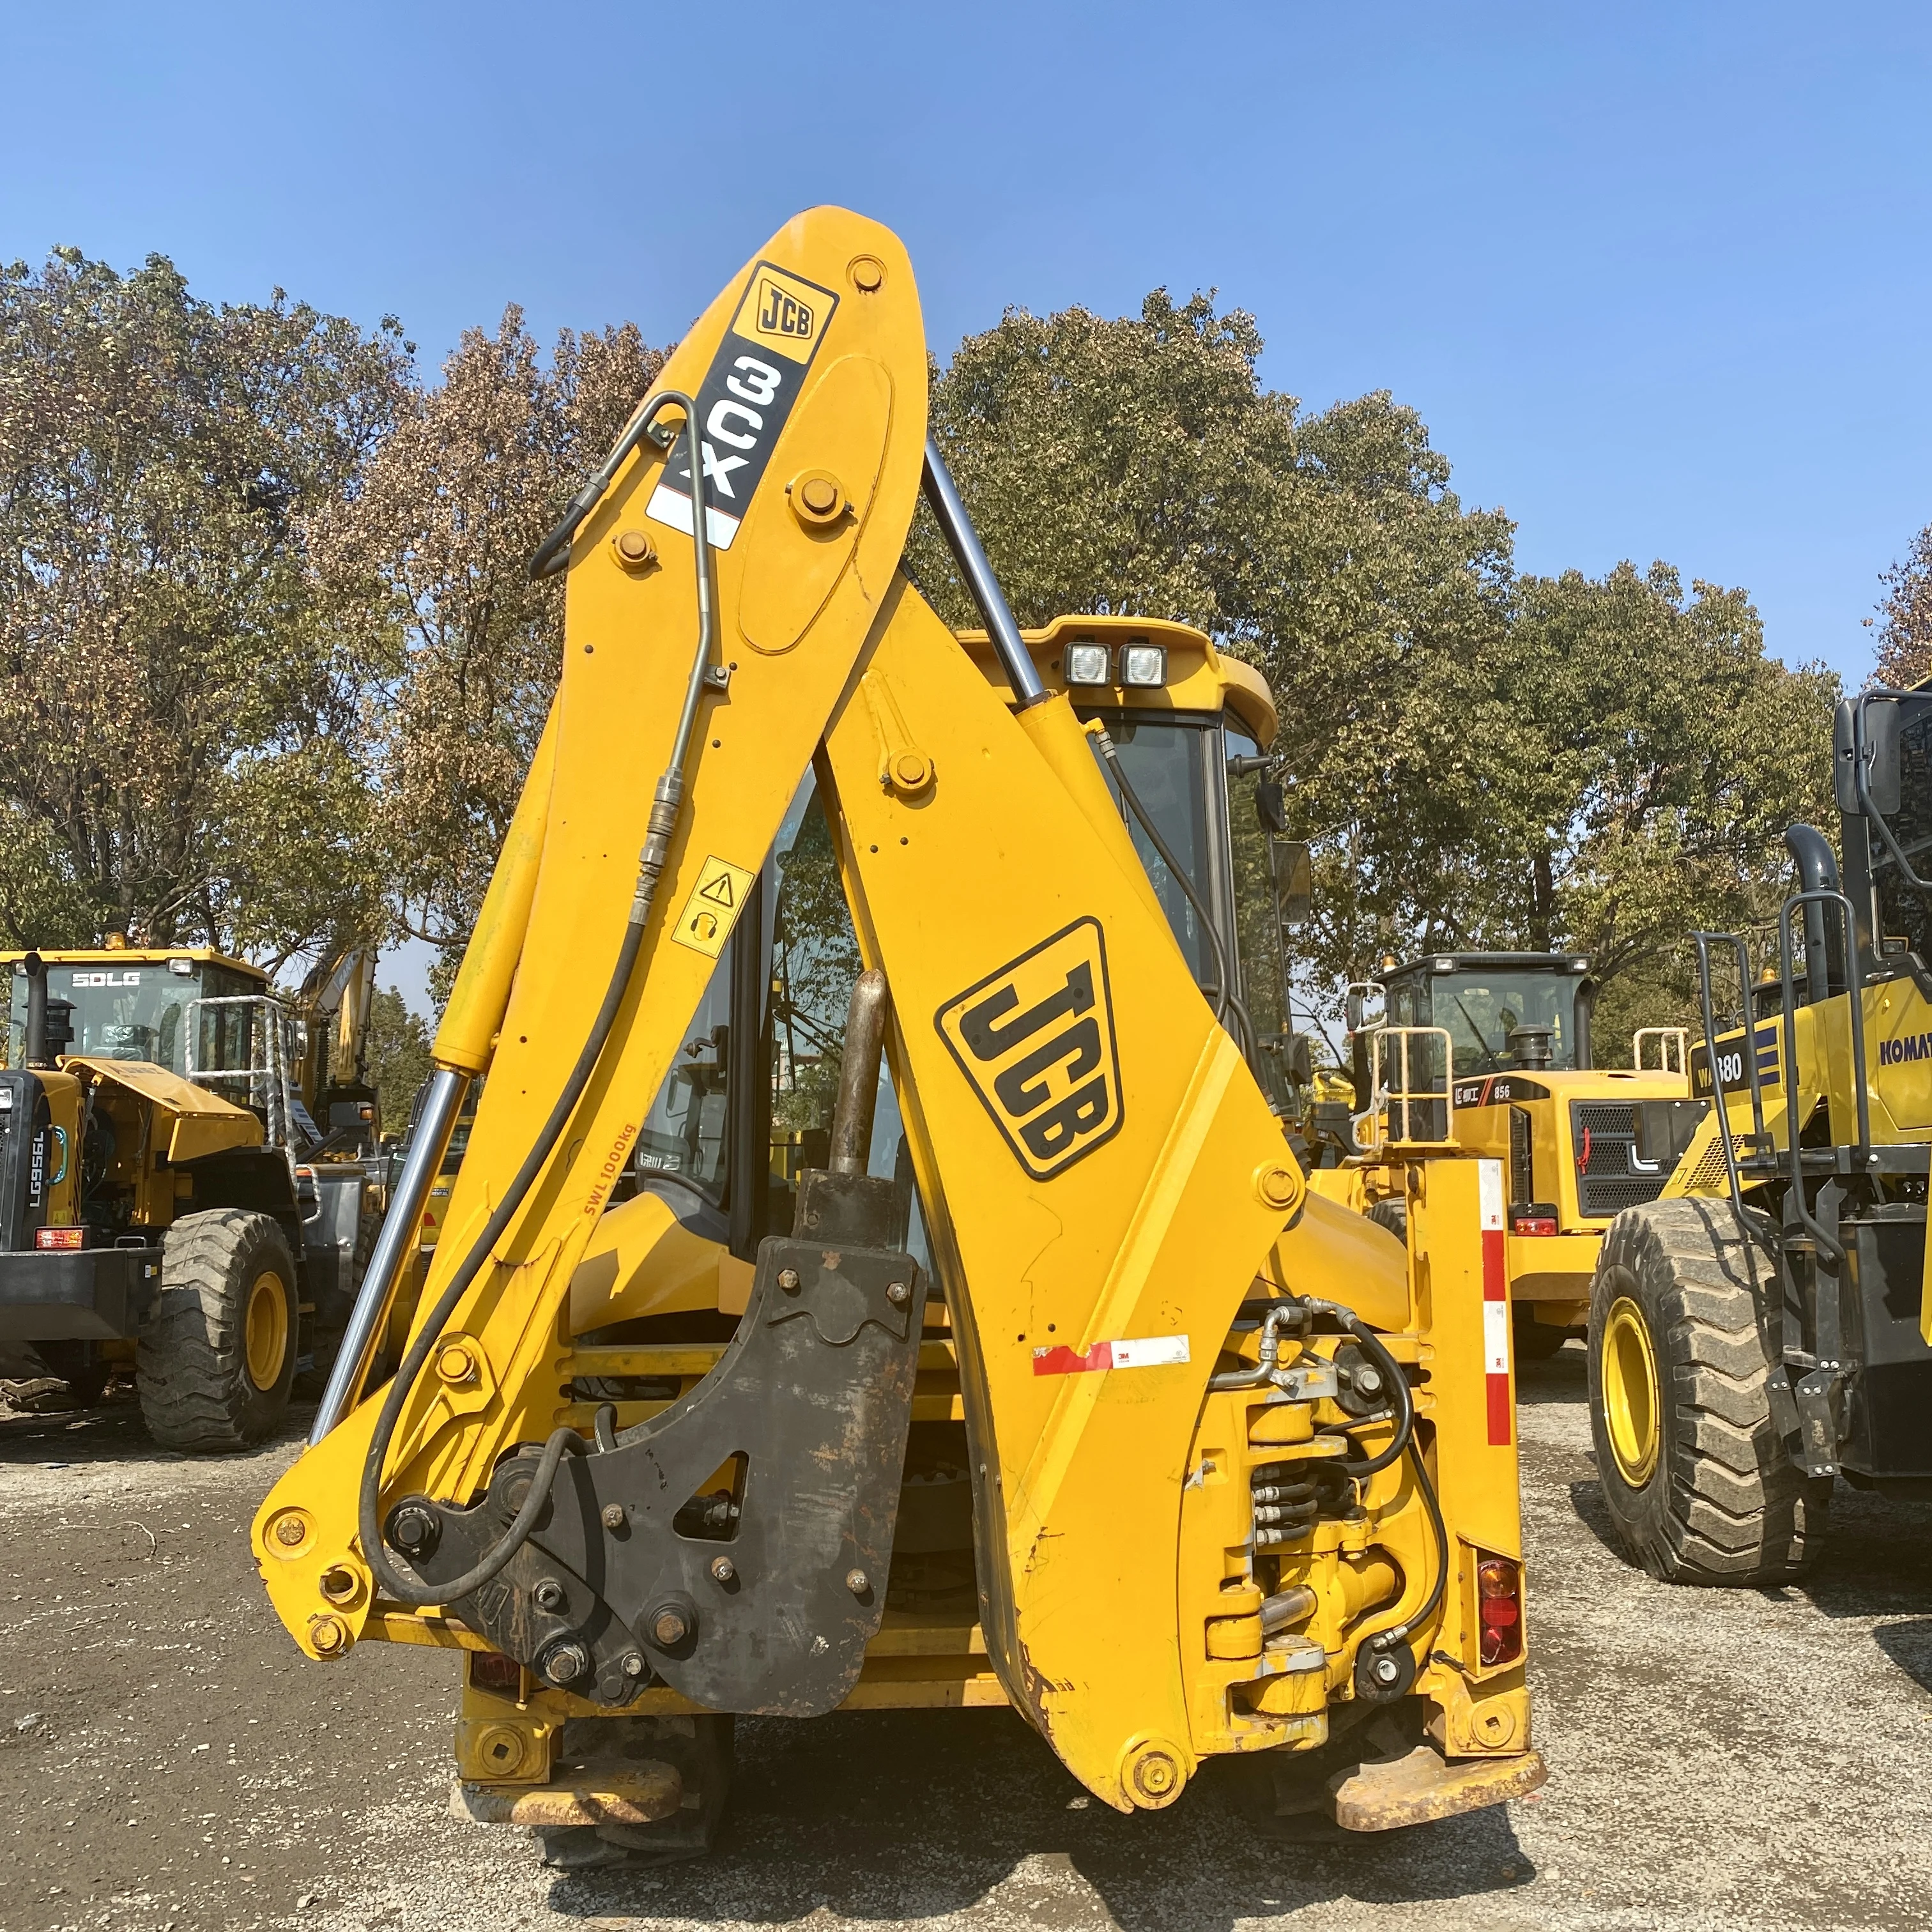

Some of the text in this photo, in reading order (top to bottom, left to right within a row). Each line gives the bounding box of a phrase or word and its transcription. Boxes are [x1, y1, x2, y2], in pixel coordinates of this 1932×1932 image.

[762, 288, 809, 335] JCB
[678, 355, 781, 500] 3CX
[72, 972, 140, 987] SDLG
[959, 959, 1109, 1160] JCB
[1494, 1085, 1510, 1099] 856
[29, 1131, 43, 1207] LG956L
[584, 1123, 637, 1216] SWL 1000kg
